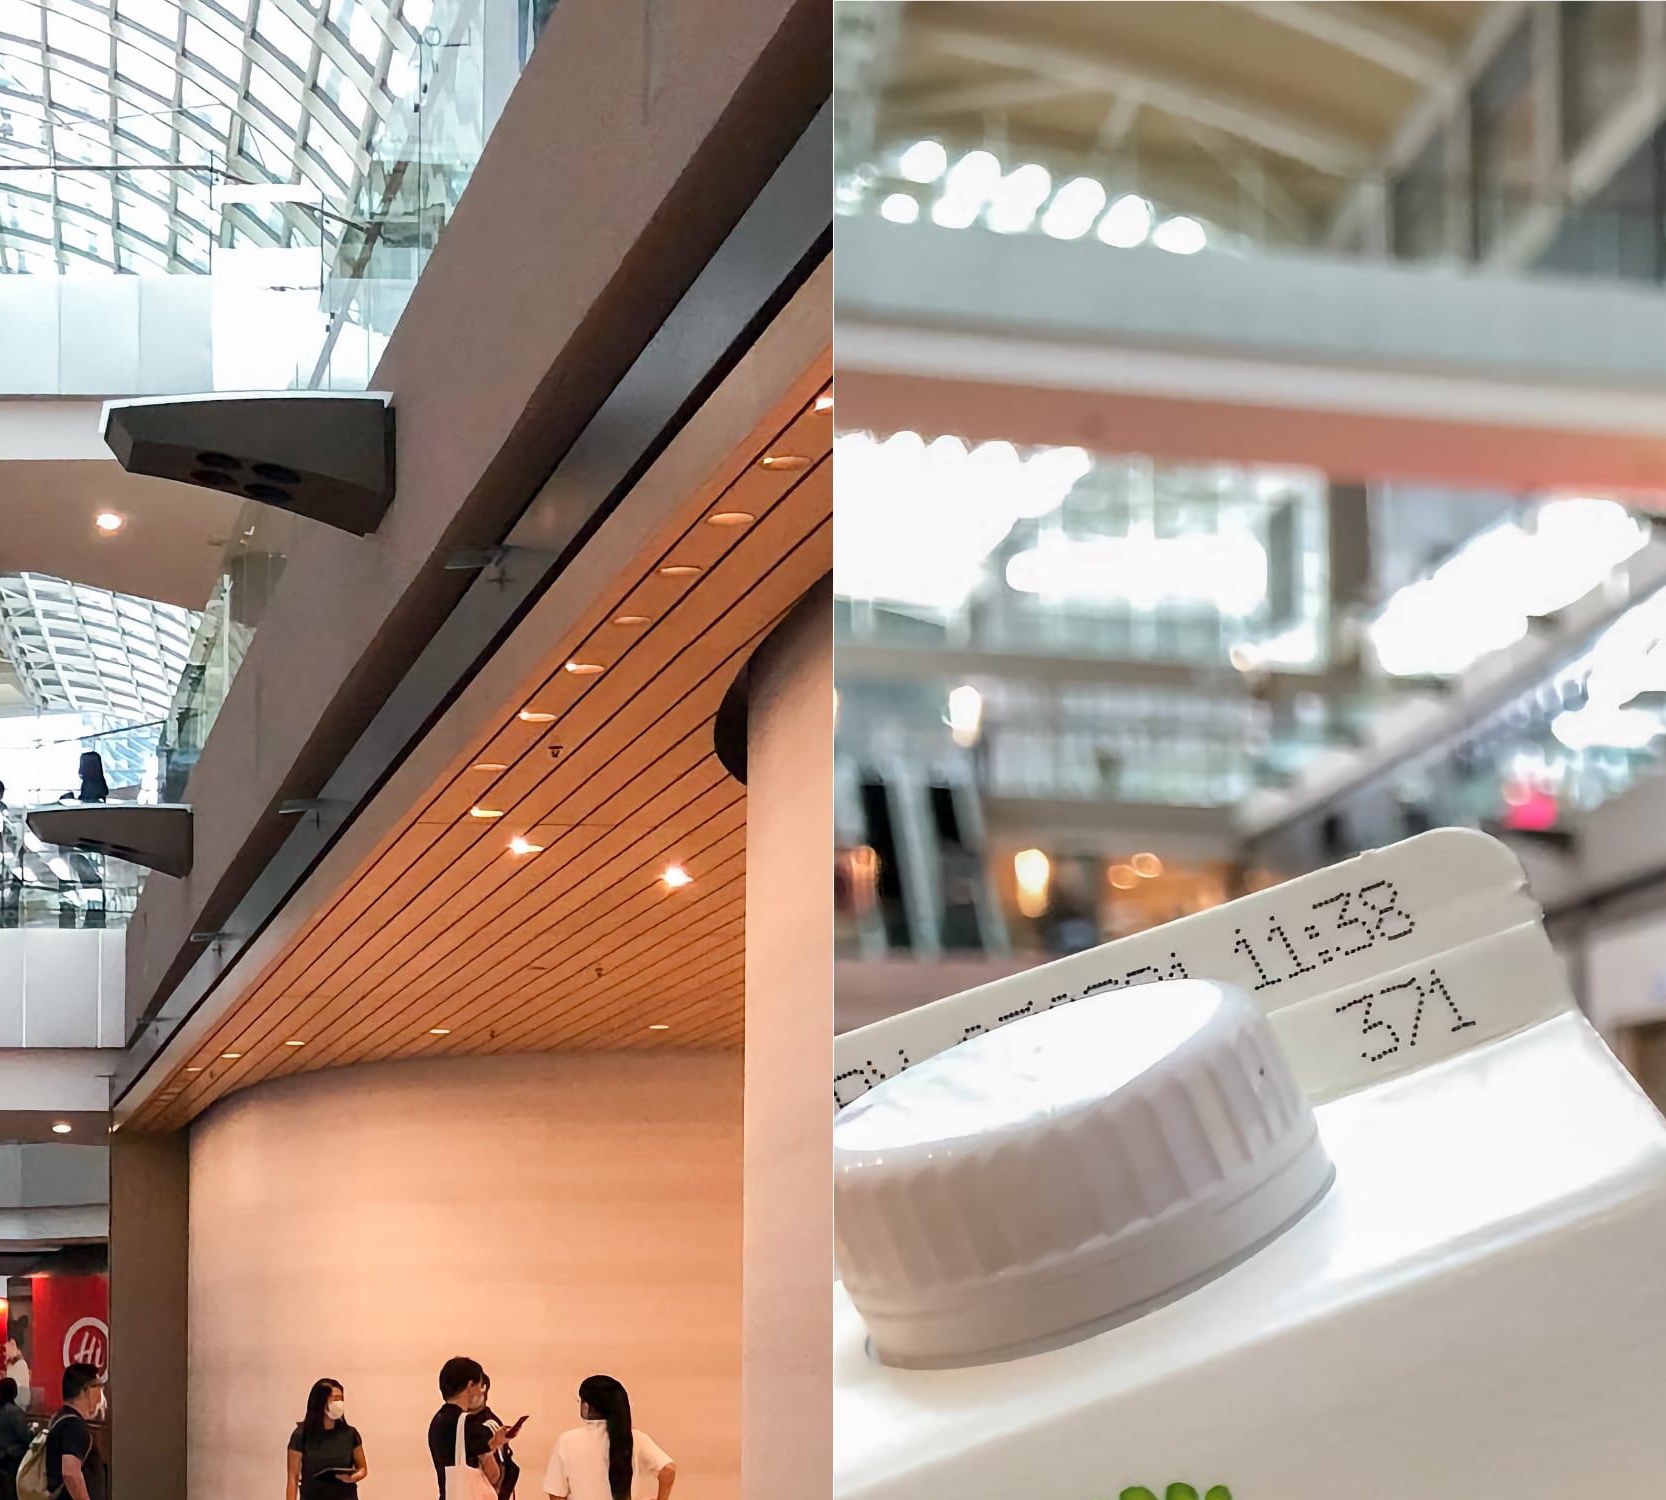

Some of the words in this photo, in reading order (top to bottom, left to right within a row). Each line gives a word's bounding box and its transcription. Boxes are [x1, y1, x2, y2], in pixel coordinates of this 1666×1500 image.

[1234, 879, 1416, 991] 11:38
[1335, 968, 1477, 1063] 371
[74, 1331, 103, 1368] Hi
